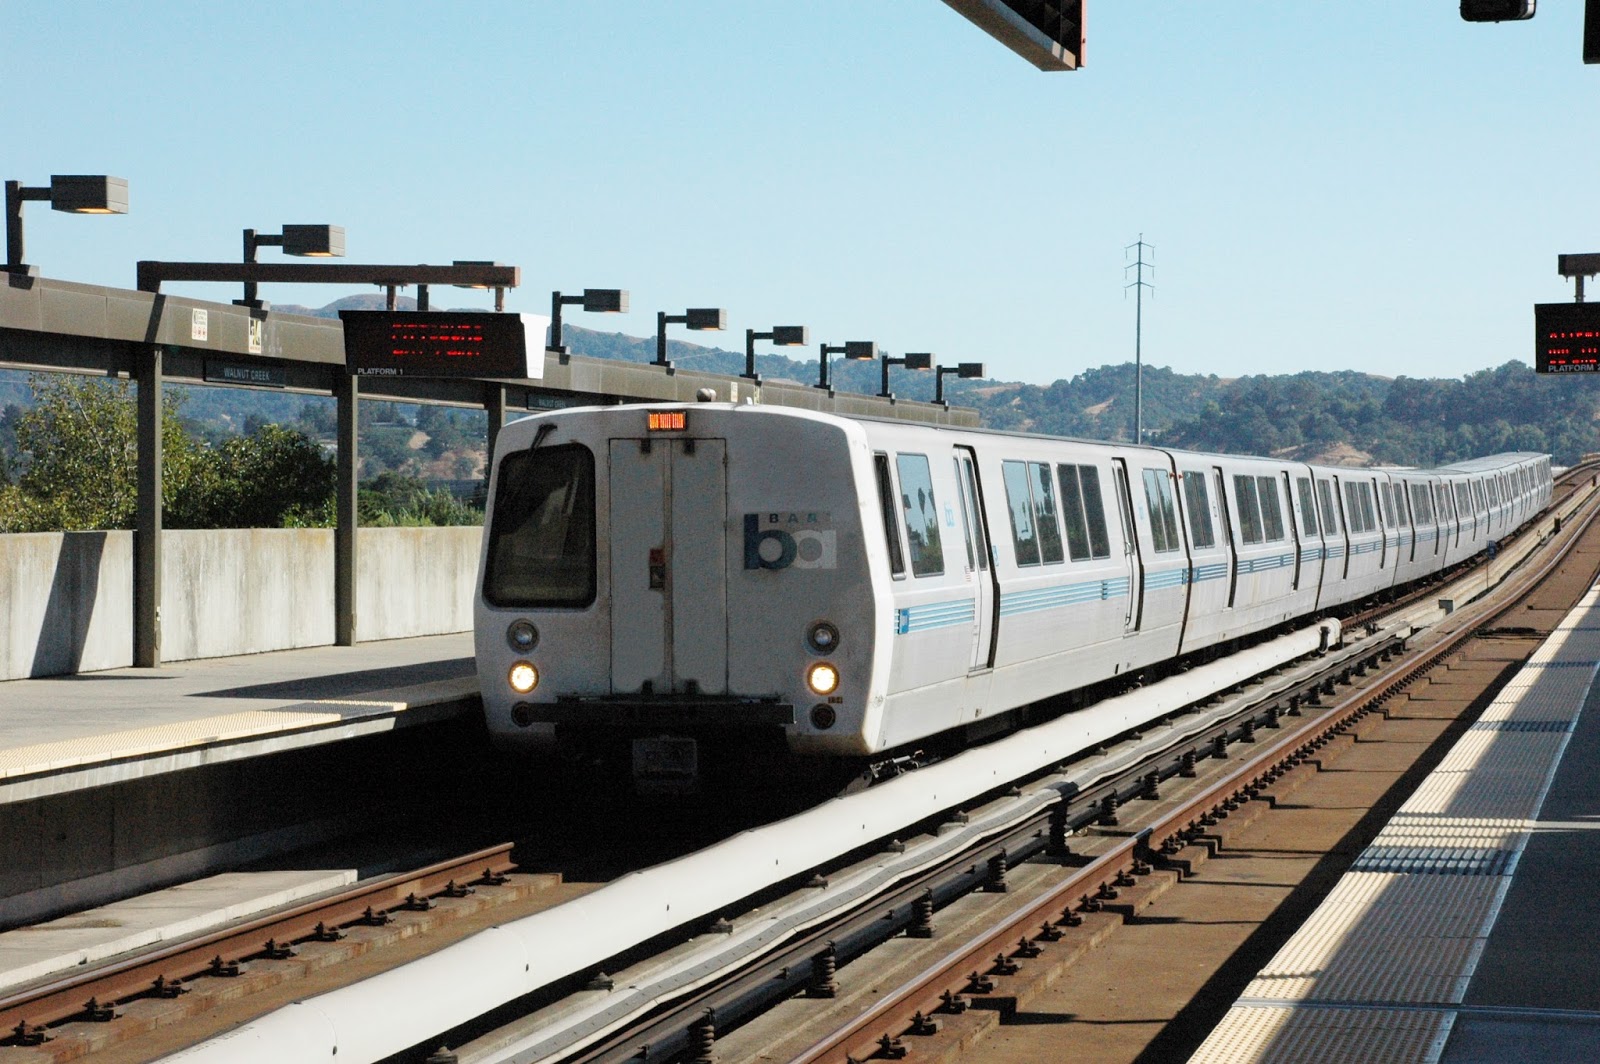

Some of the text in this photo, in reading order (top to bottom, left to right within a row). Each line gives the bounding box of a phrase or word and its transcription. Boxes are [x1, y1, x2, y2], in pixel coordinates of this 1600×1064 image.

[357, 367, 397, 375] PLATFORM
[1548, 364, 1594, 372] PLATFORM
[224, 367, 270, 381] WALNUT CREEK
